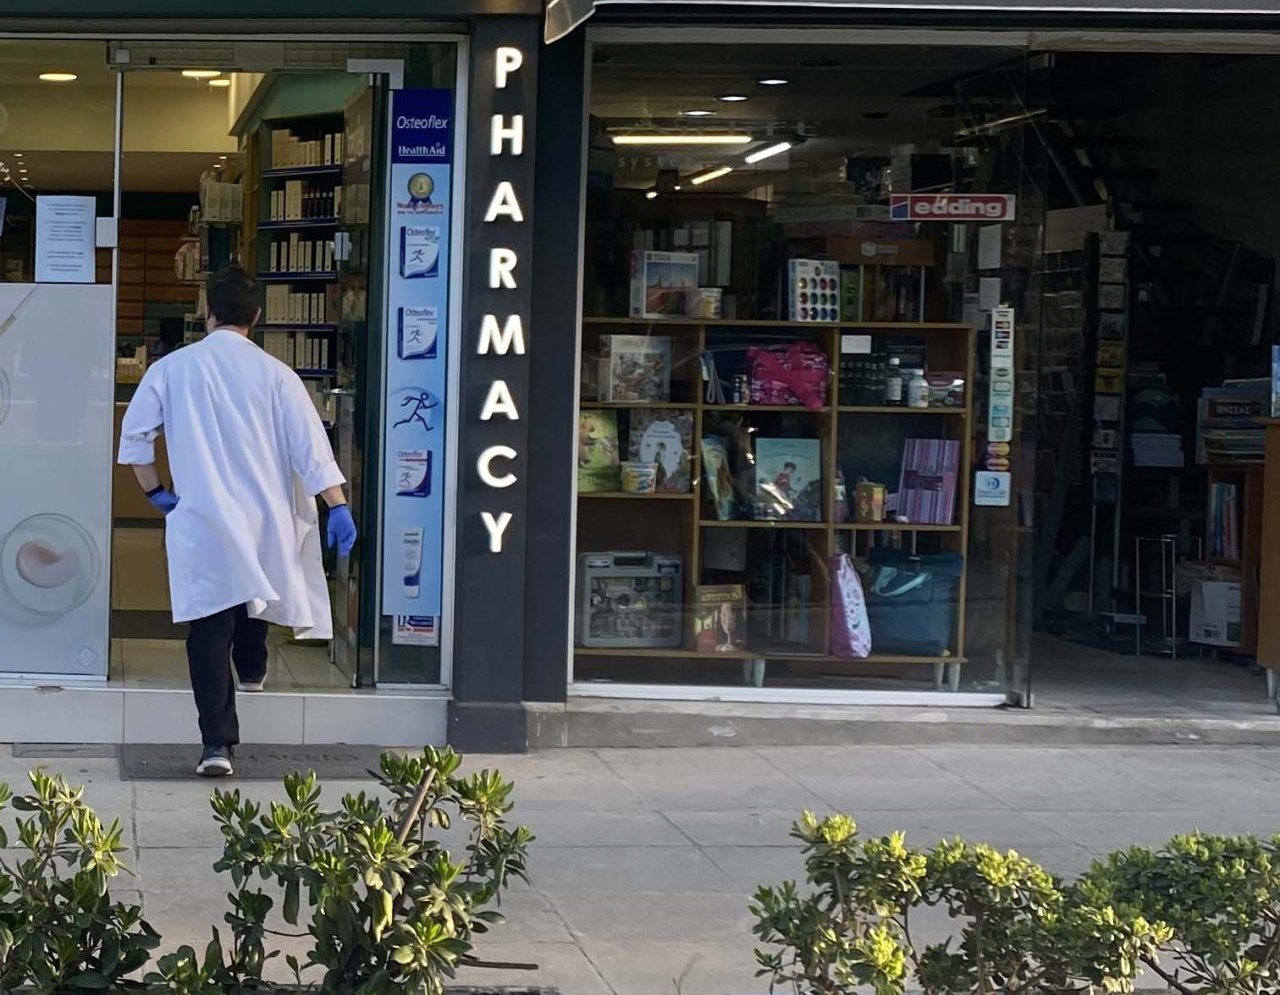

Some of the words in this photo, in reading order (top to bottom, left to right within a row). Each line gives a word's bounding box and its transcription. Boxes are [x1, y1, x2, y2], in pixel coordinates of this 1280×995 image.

[396, 115, 448, 129] Osteoflex
[914, 198, 1002, 217] edding
[477, 47, 526, 554] PHARMACY
